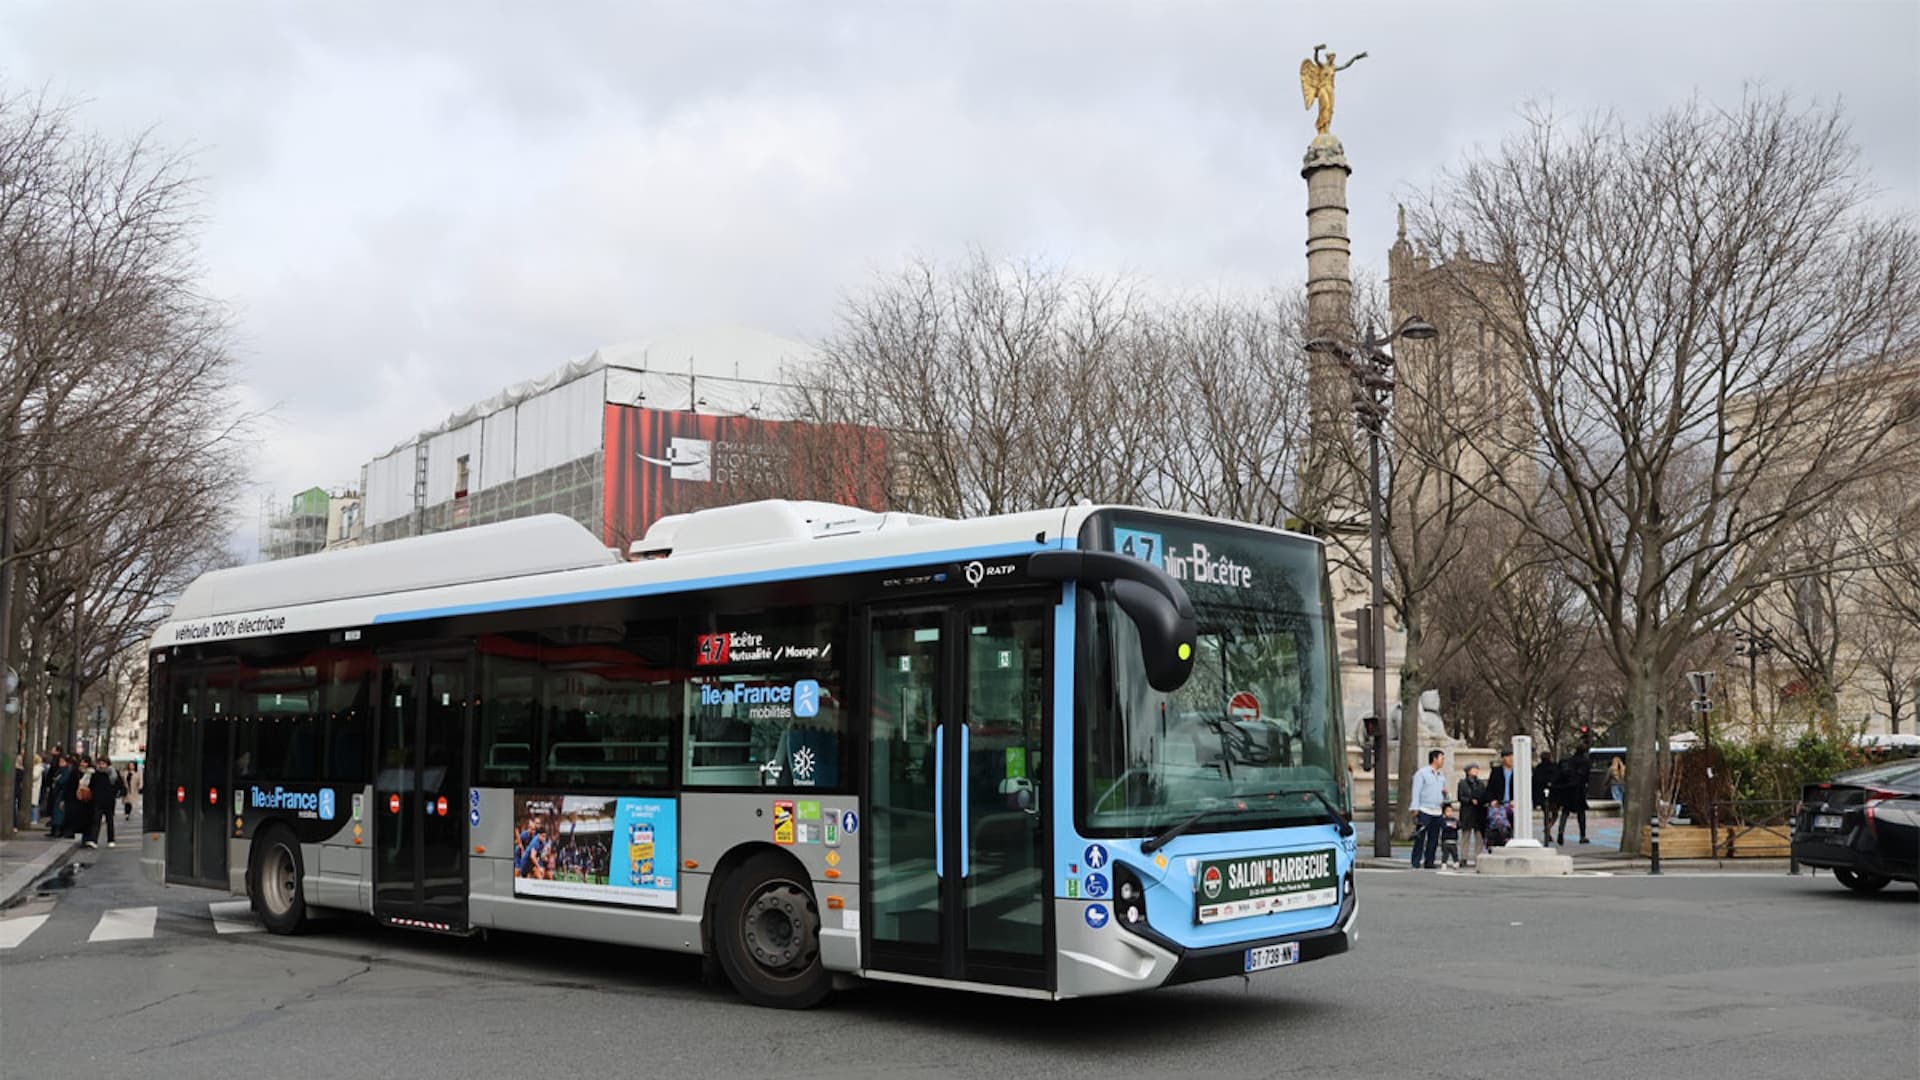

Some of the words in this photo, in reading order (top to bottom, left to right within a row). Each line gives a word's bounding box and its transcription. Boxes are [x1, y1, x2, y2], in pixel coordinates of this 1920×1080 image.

[1121, 535, 1154, 562] 47
[986, 565, 1016, 576] RATP
[175, 623, 210, 640] véhicule
[212, 621, 236, 638] 100%
[237, 616, 286, 634] électrique
[700, 635, 726, 662] 47
[785, 645, 819, 659] Monge
[749, 704, 792, 718] mobilités
[1228, 858, 1267, 890] SALON
[1271, 853, 1331, 882] BARBECUE
